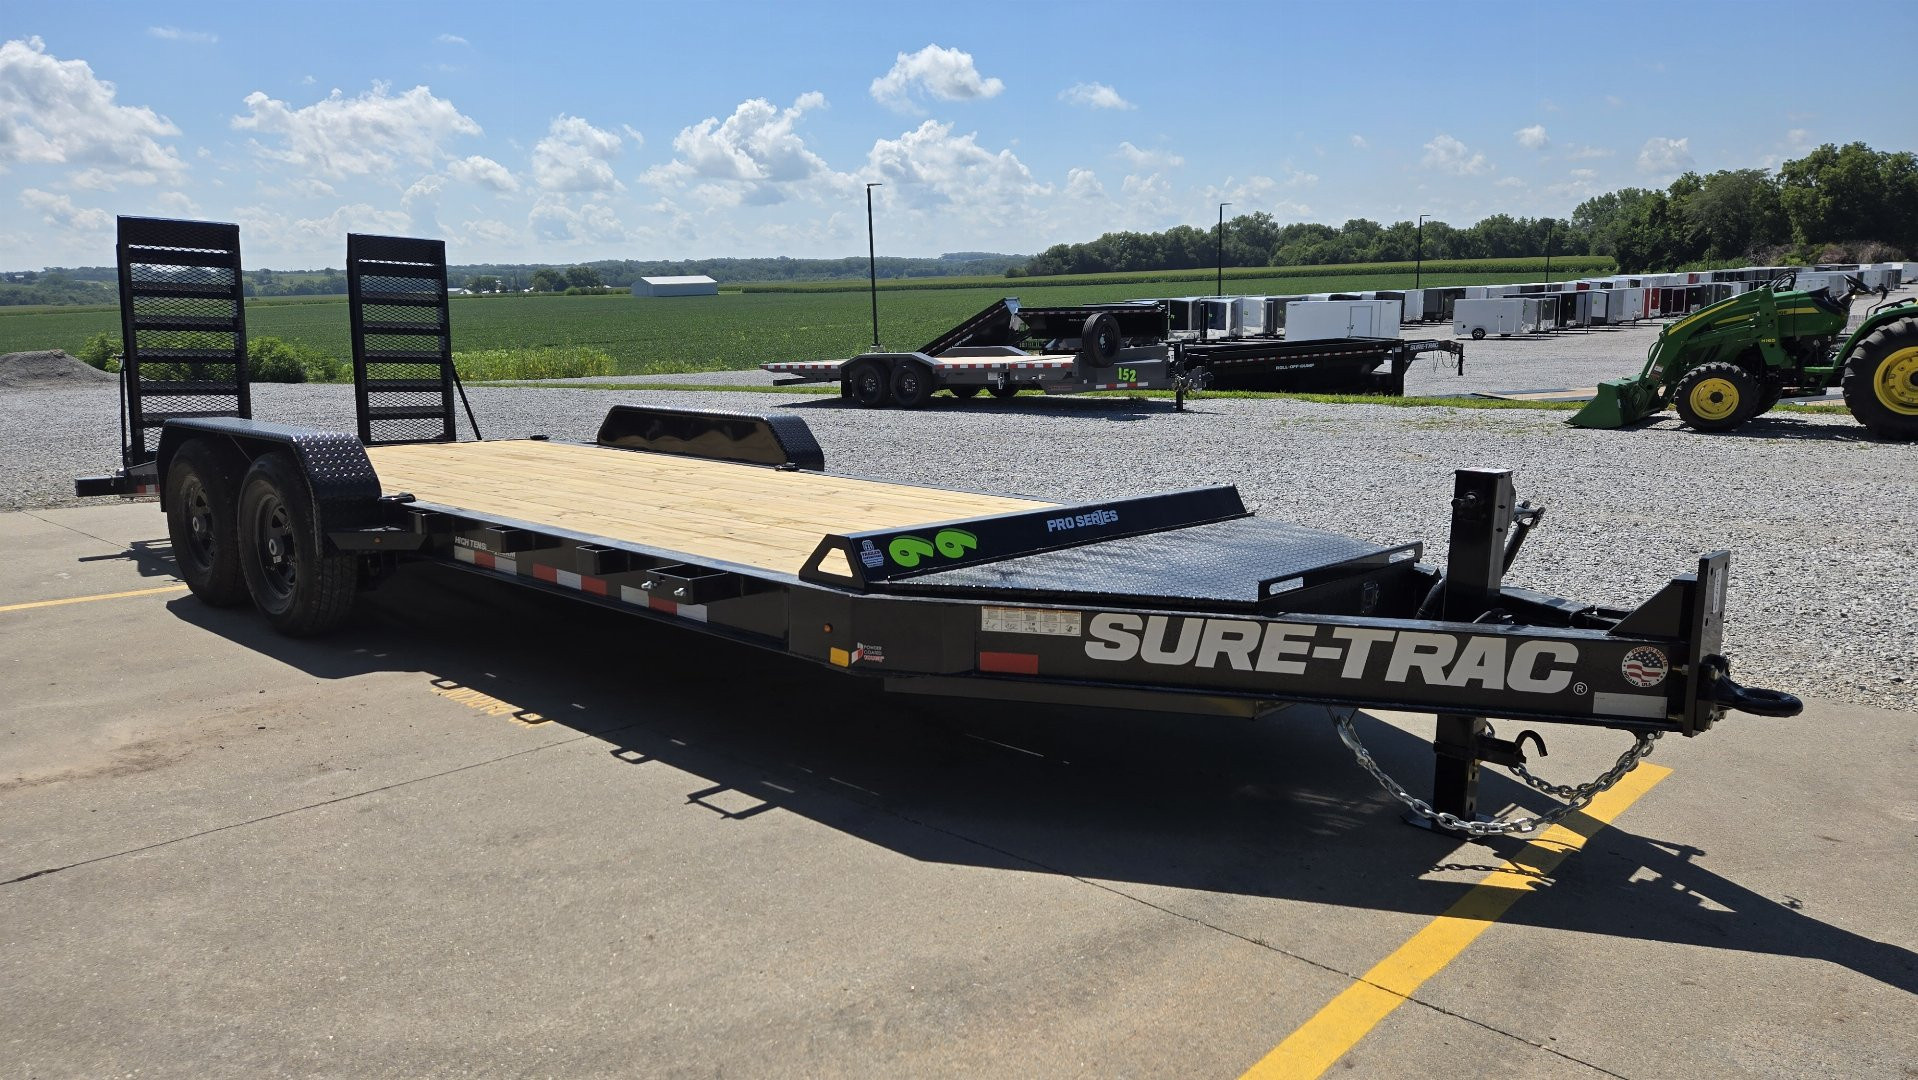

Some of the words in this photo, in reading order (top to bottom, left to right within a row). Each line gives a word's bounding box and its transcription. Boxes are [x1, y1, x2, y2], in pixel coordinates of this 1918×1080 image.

[1410, 342, 1439, 350] SURE-TRAC
[1118, 367, 1137, 382] 152
[1047, 517, 1075, 532] PRO
[1076, 510, 1119, 526] SERIES
[455, 536, 470, 546] HIGH
[1085, 612, 1579, 694] SURE-TRAC
